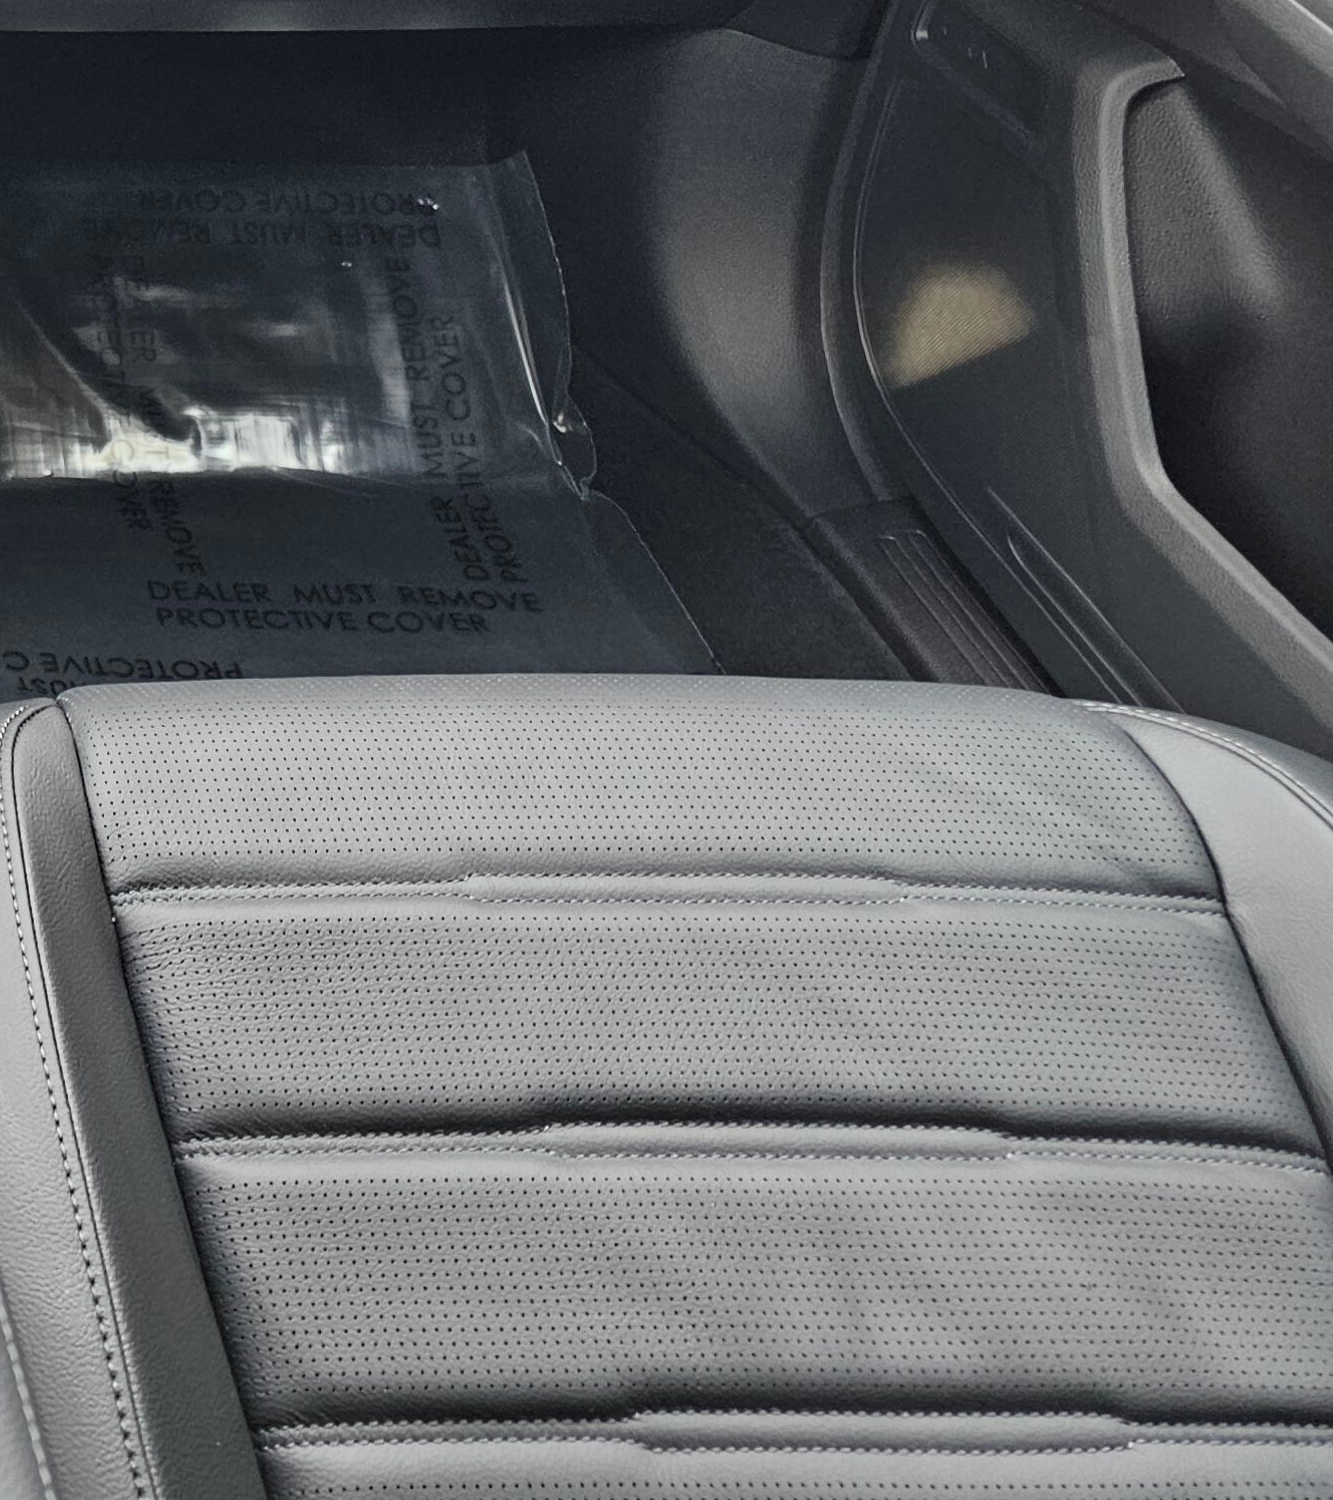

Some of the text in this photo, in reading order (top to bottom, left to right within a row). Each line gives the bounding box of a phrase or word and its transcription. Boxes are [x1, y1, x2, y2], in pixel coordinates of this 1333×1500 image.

[147, 579, 544, 613] DEALER MUST REMOVE
[155, 606, 490, 634] PROTECTIVE COVER
[39, 653, 244, 681] PROTECTIVE
